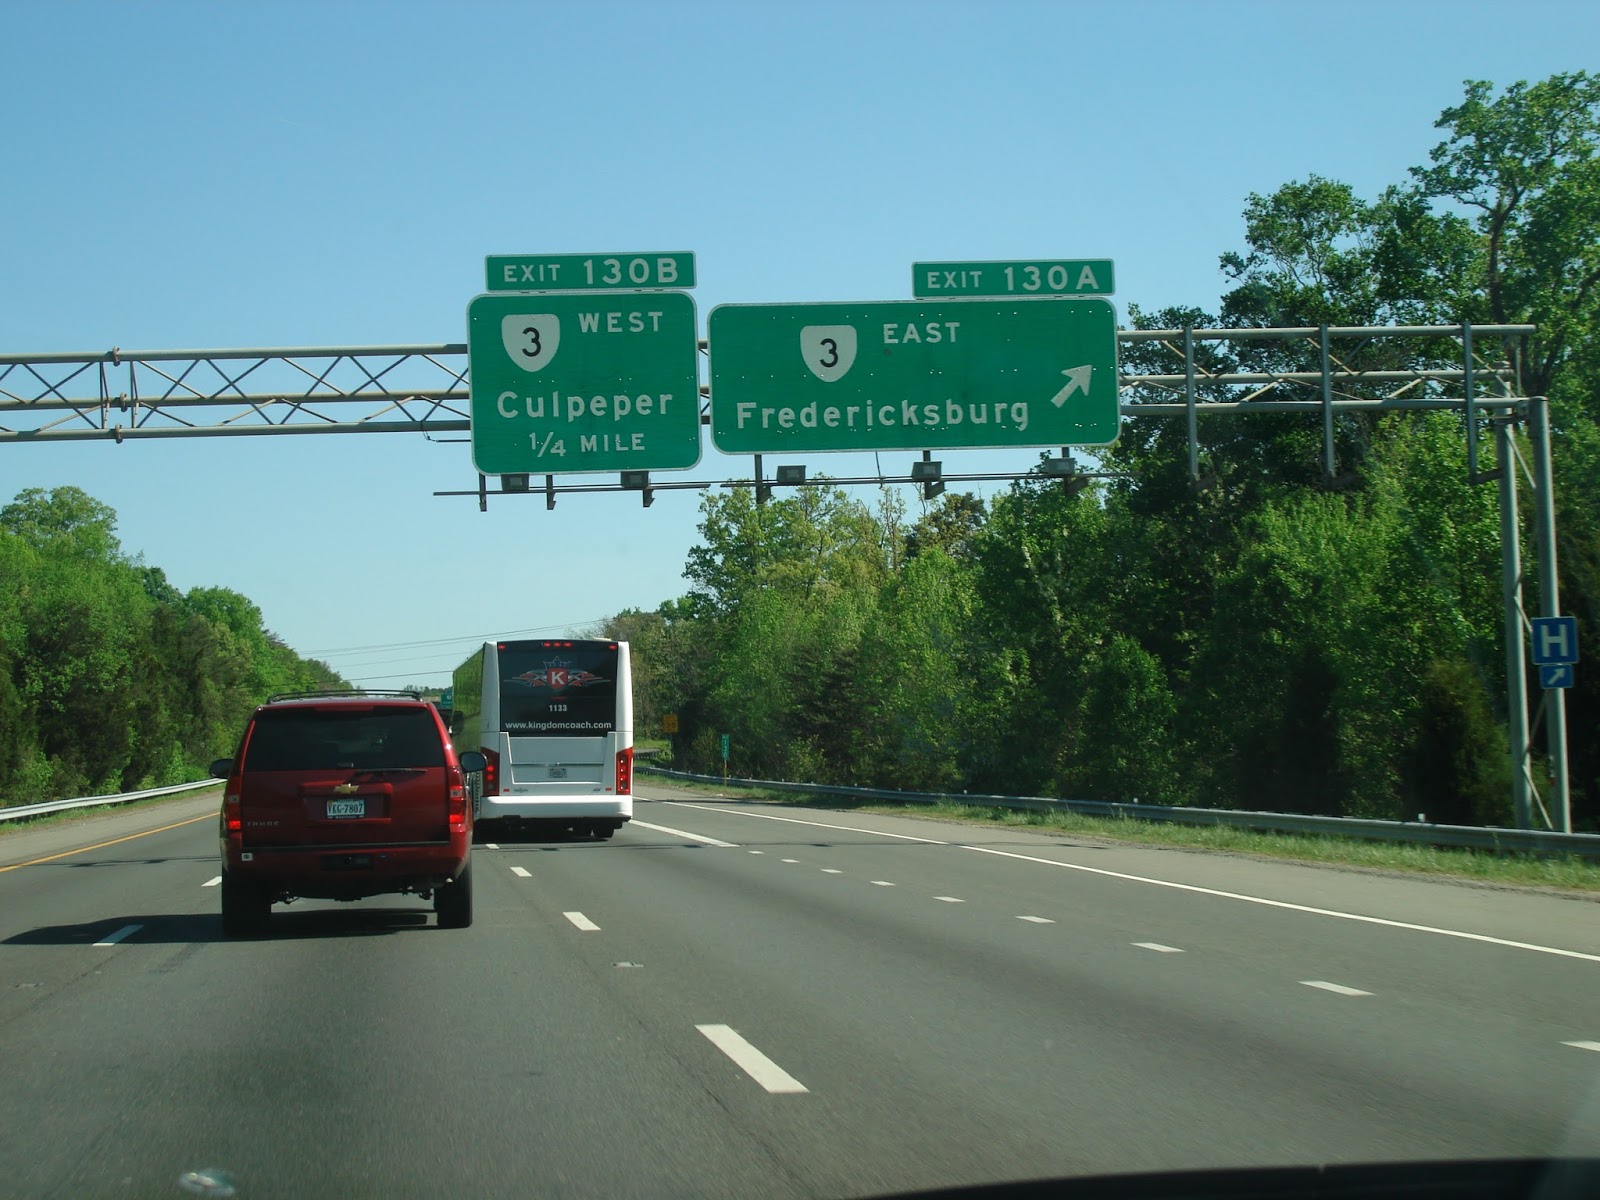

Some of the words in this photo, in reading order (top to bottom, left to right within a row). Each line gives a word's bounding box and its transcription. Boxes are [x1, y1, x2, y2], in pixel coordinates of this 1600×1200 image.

[503, 264, 561, 283] EXIT
[583, 257, 679, 285] 130B
[926, 270, 982, 289] EXIT
[1004, 264, 1100, 292] 130A
[578, 311, 663, 333] WEST
[882, 321, 961, 344] EAST
[521, 327, 542, 358] 3
[819, 337, 839, 368] 3
[497, 390, 673, 423] Culpeper
[736, 398, 1028, 432] Fredericksburg
[580, 433, 646, 453] MILE
[1540, 624, 1568, 657] H
[551, 671, 565, 685] K
[548, 704, 568, 712] 1133
[505, 721, 612, 731] www.kingdomcoach.com
